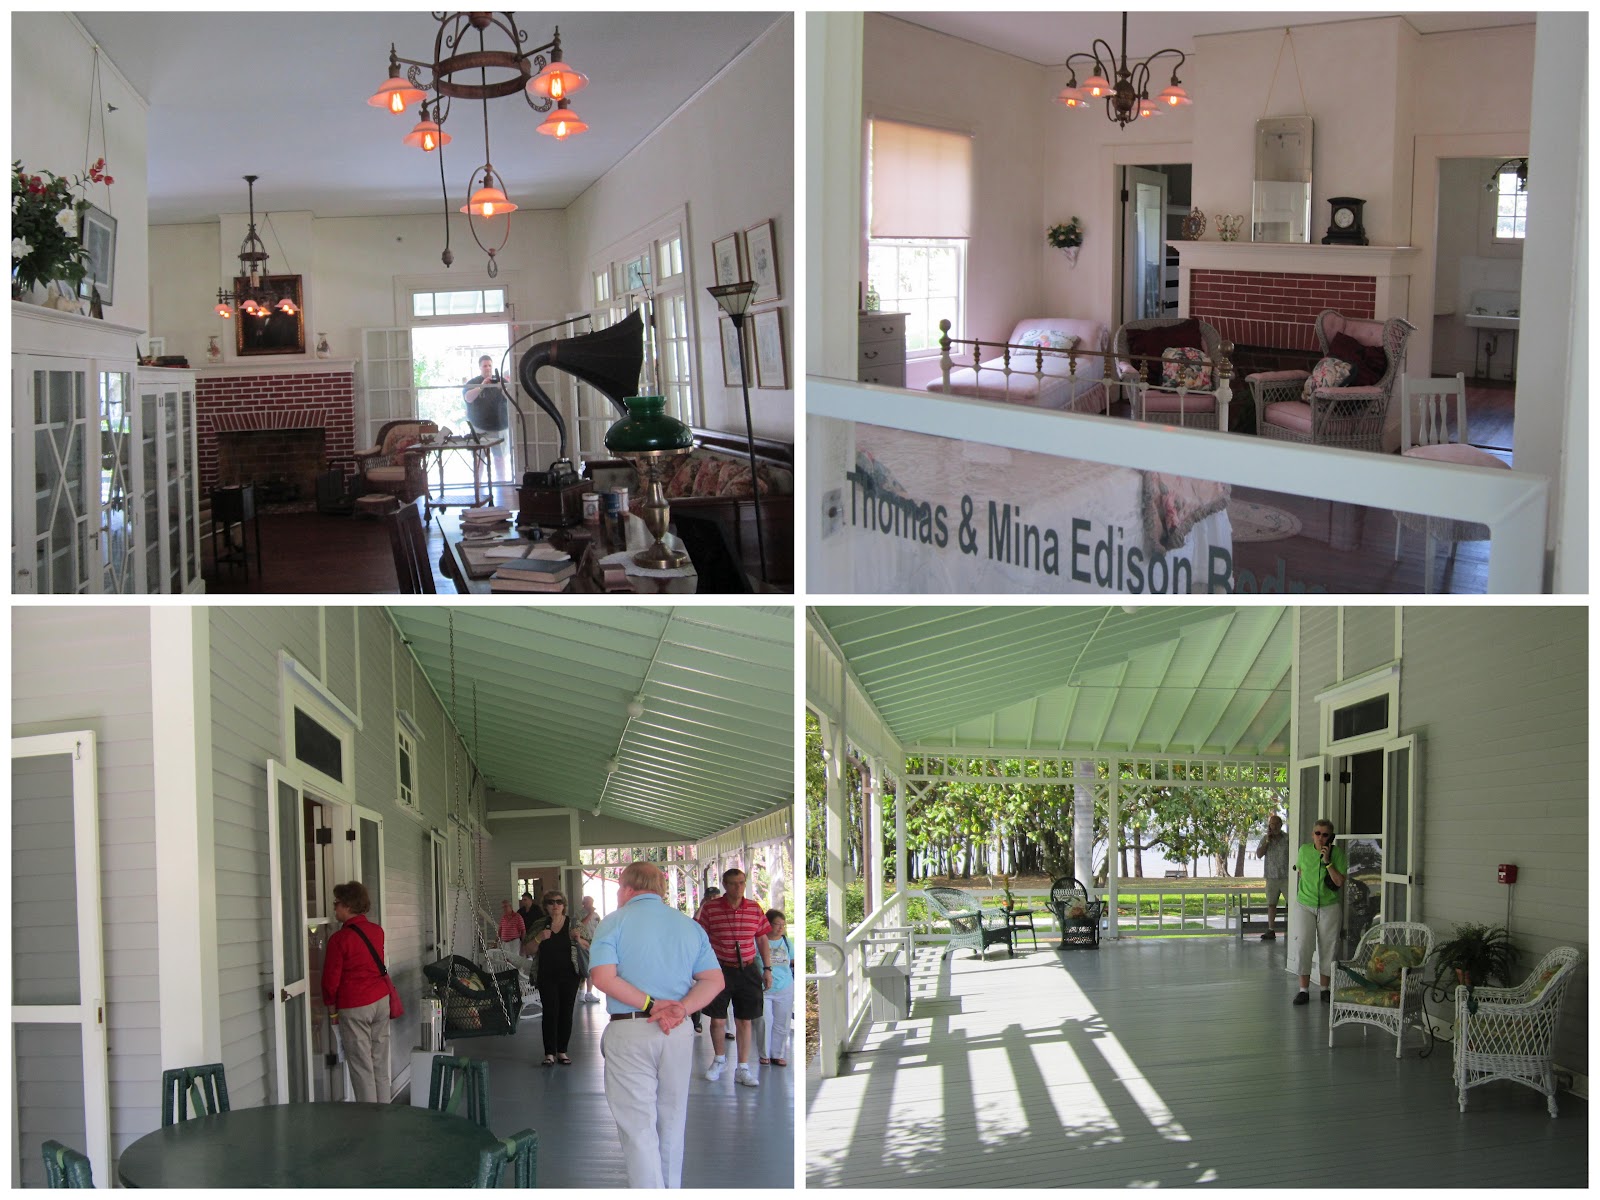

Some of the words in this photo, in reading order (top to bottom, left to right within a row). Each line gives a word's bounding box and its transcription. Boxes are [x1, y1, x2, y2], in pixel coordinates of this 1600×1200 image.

[847, 471, 949, 549] Thomas
[958, 494, 979, 557] &
[988, 500, 1060, 576] Mina
[1071, 517, 1193, 594] Edison
